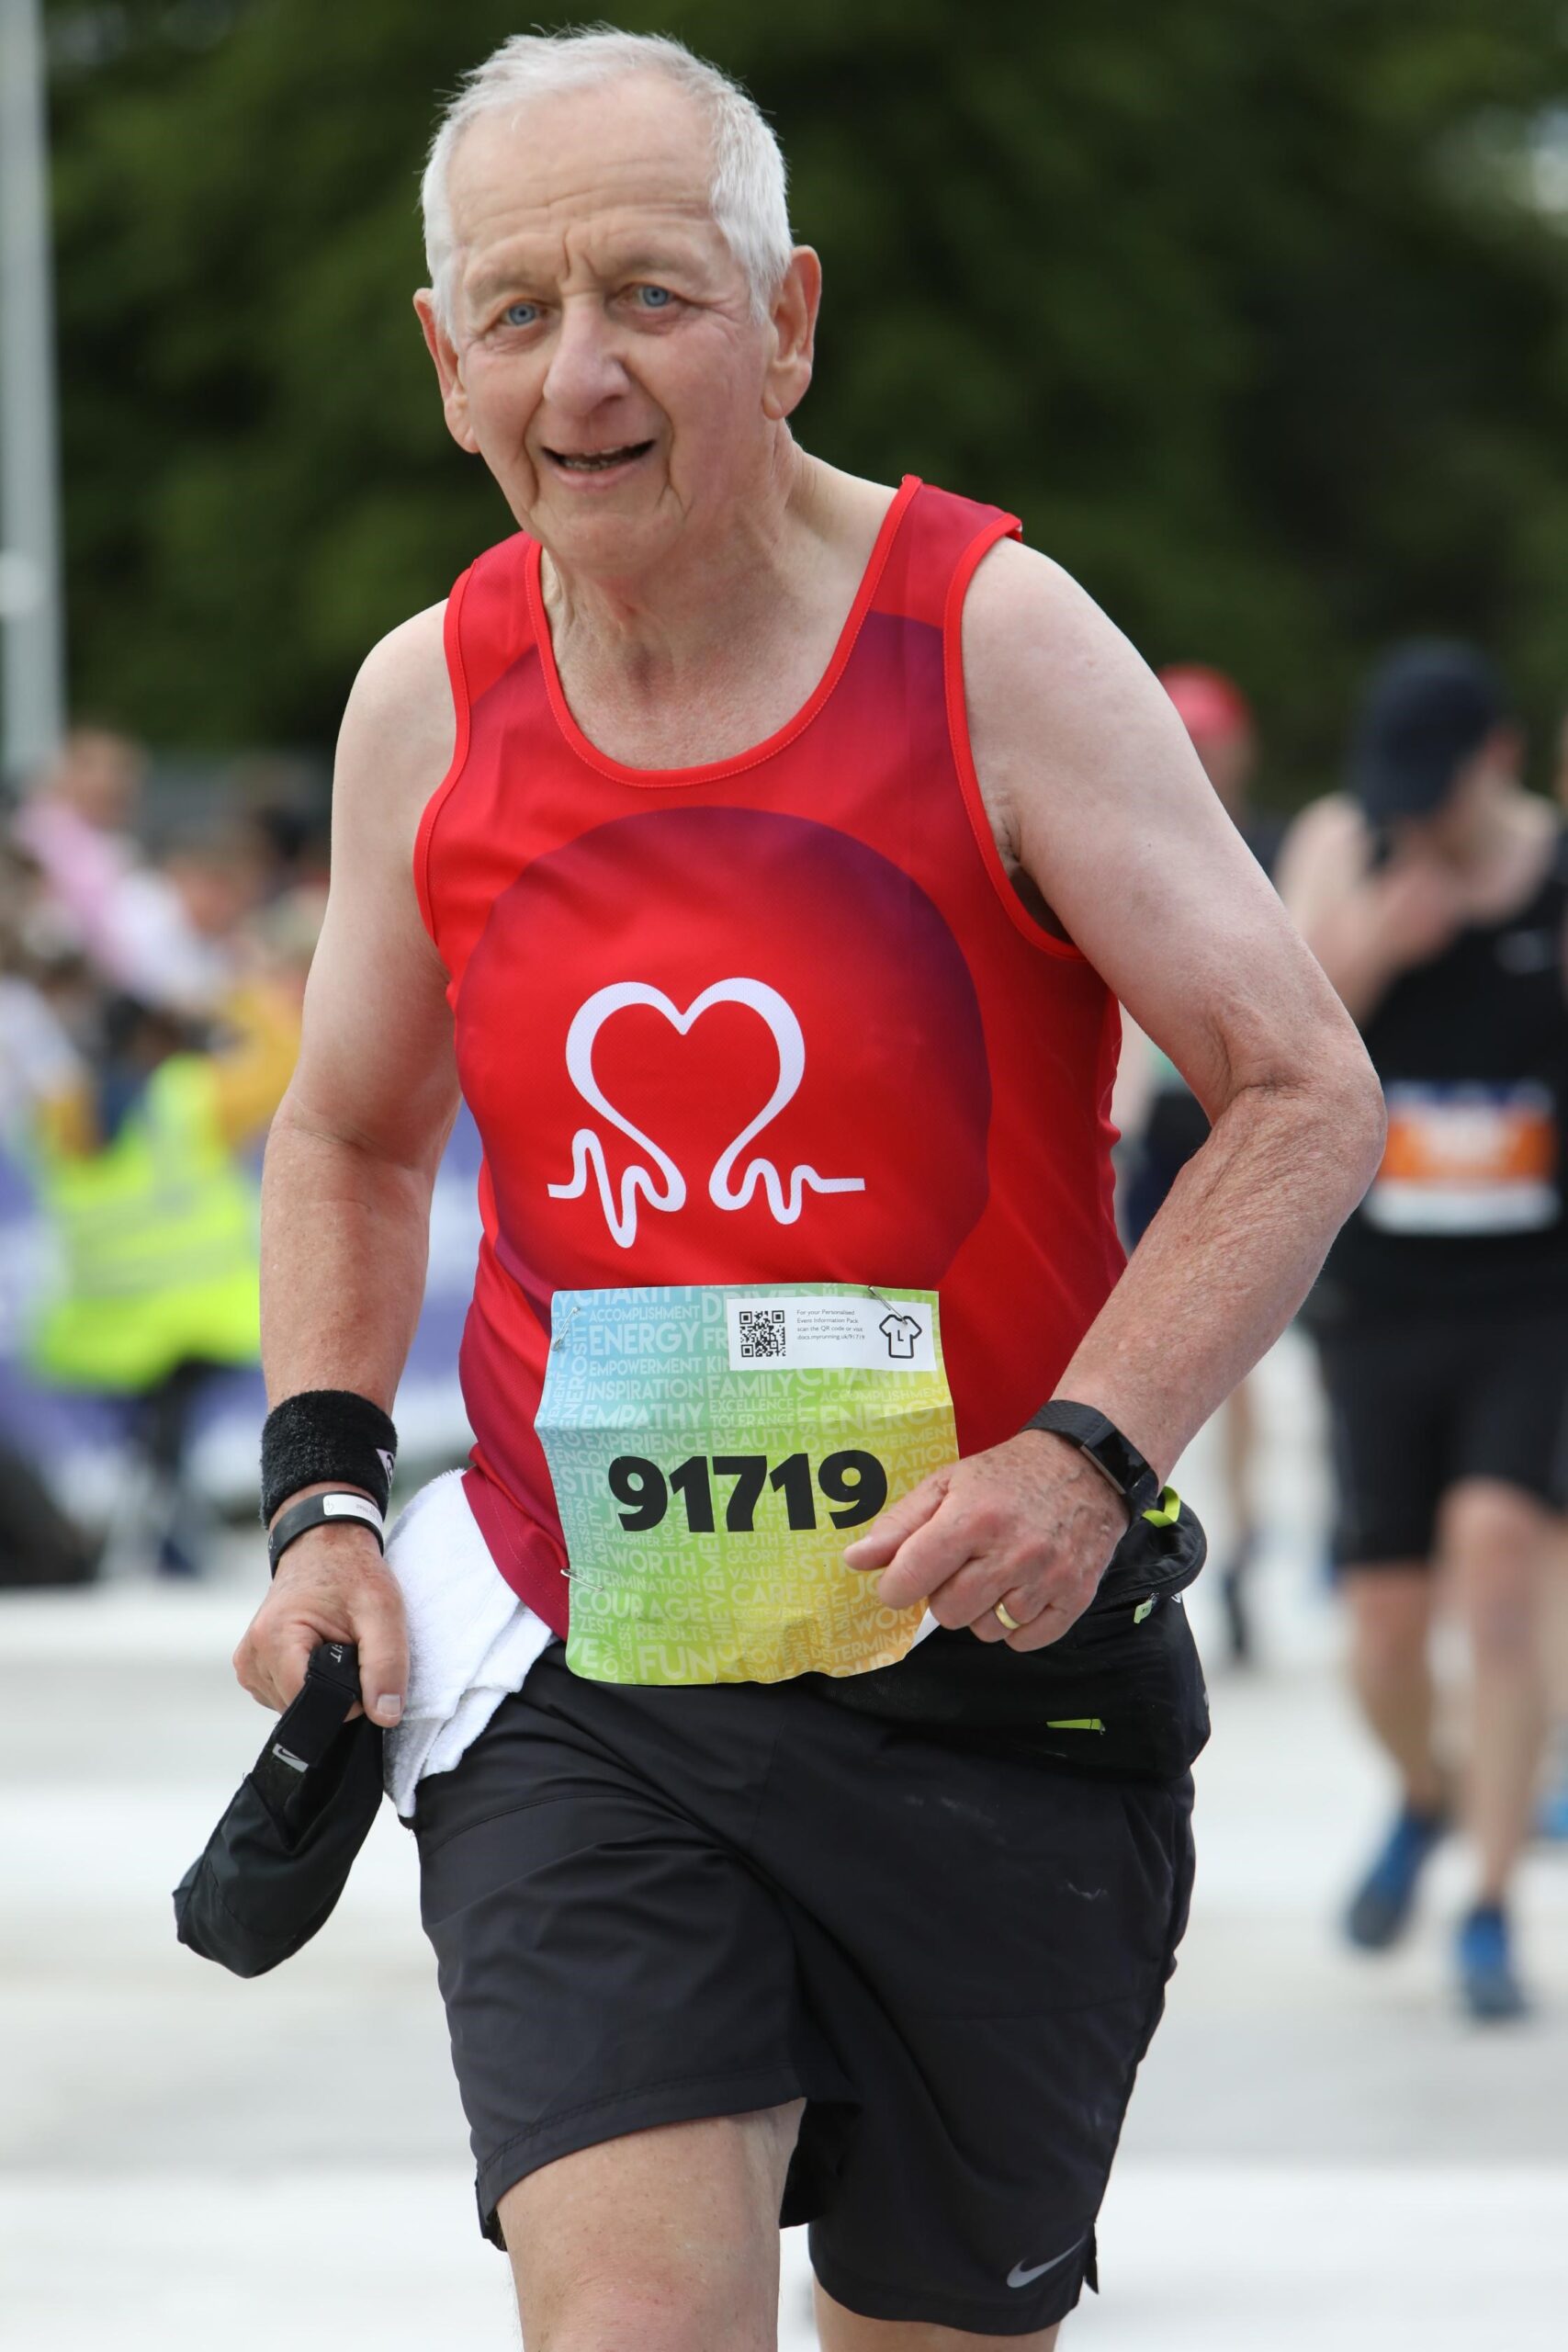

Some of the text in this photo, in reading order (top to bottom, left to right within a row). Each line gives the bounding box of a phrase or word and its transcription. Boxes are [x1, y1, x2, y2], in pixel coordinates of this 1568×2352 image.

[589, 1305, 701, 1323] ACCOMPLISHMENT
[590, 1321, 701, 1356] ENERGY
[897, 1329, 904, 1341] L
[589, 1356, 703, 1376] EMPOWERMENT
[586, 1377, 705, 1401] INSPIRATION
[707, 1372, 795, 1399] FAMILY
[710, 1397, 795, 1413] EXCELLENCE
[820, 1397, 954, 1435] ENERGY
[579, 1403, 705, 1430] EMPATHY
[710, 1412, 795, 1428] TOLERANCE
[582, 1431, 709, 1454] EXPERIENCE
[711, 1428, 795, 1450] BEAUTY
[608, 1449, 888, 1533] 91719
[605, 1532, 661, 1547] LAUGHTER
[724, 1531, 780, 1548] TRUTH
[608, 1546, 697, 1576] WORTH
[726, 1549, 780, 1565] GLORY
[575, 1566, 702, 1595] DETERMINATION
[728, 1565, 782, 1581] VALUE
[574, 1586, 707, 1623] COURAGE
[730, 1582, 801, 1607] CARE
[578, 1614, 615, 1636] ZEST
[635, 1623, 711, 1643] RESULTS
[637, 1644, 719, 1681] FUN
